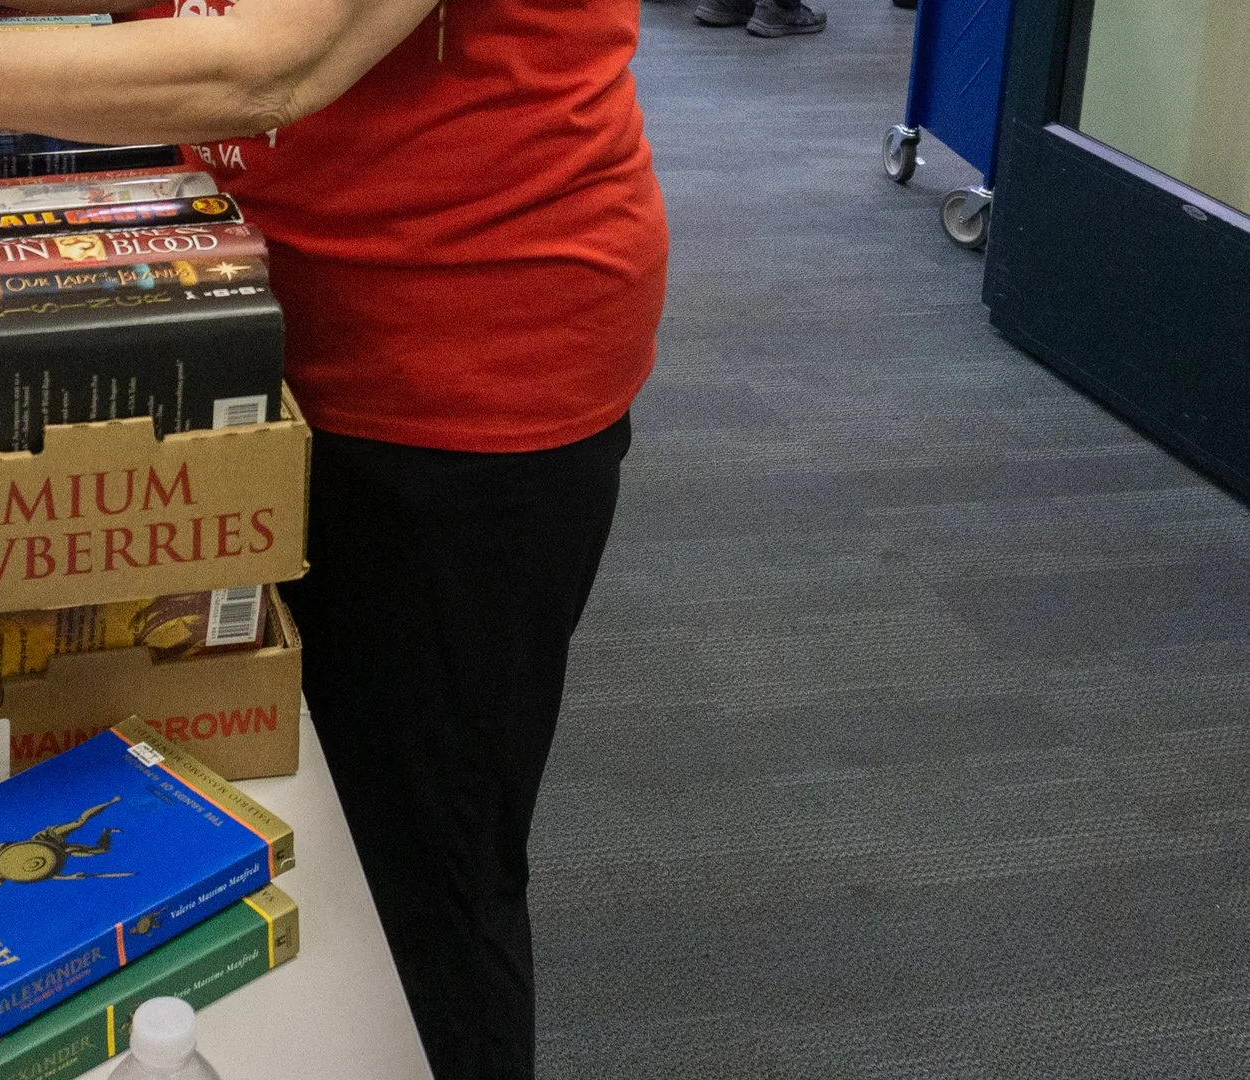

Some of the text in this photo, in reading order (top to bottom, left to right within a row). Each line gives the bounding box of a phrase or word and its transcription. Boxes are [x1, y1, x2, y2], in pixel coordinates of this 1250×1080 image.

[26, 15, 64, 23] REALM
[218, 143, 247, 171] VA
[0, 210, 62, 228] ALL
[112, 234, 218, 257] BLOOD
[10, 726, 105, 762] MAIN
[180, 760, 228, 795] MASSIMO
[172, 790, 203, 813] SANDS
[228, 793, 272, 825] VALERIO
[206, 809, 223, 827] THE
[170, 862, 261, 919] Valerio Massimo Manfredi
[0, 946, 107, 1015] ALEXANDER
[193, 948, 260, 991] Massimo Manfredi
